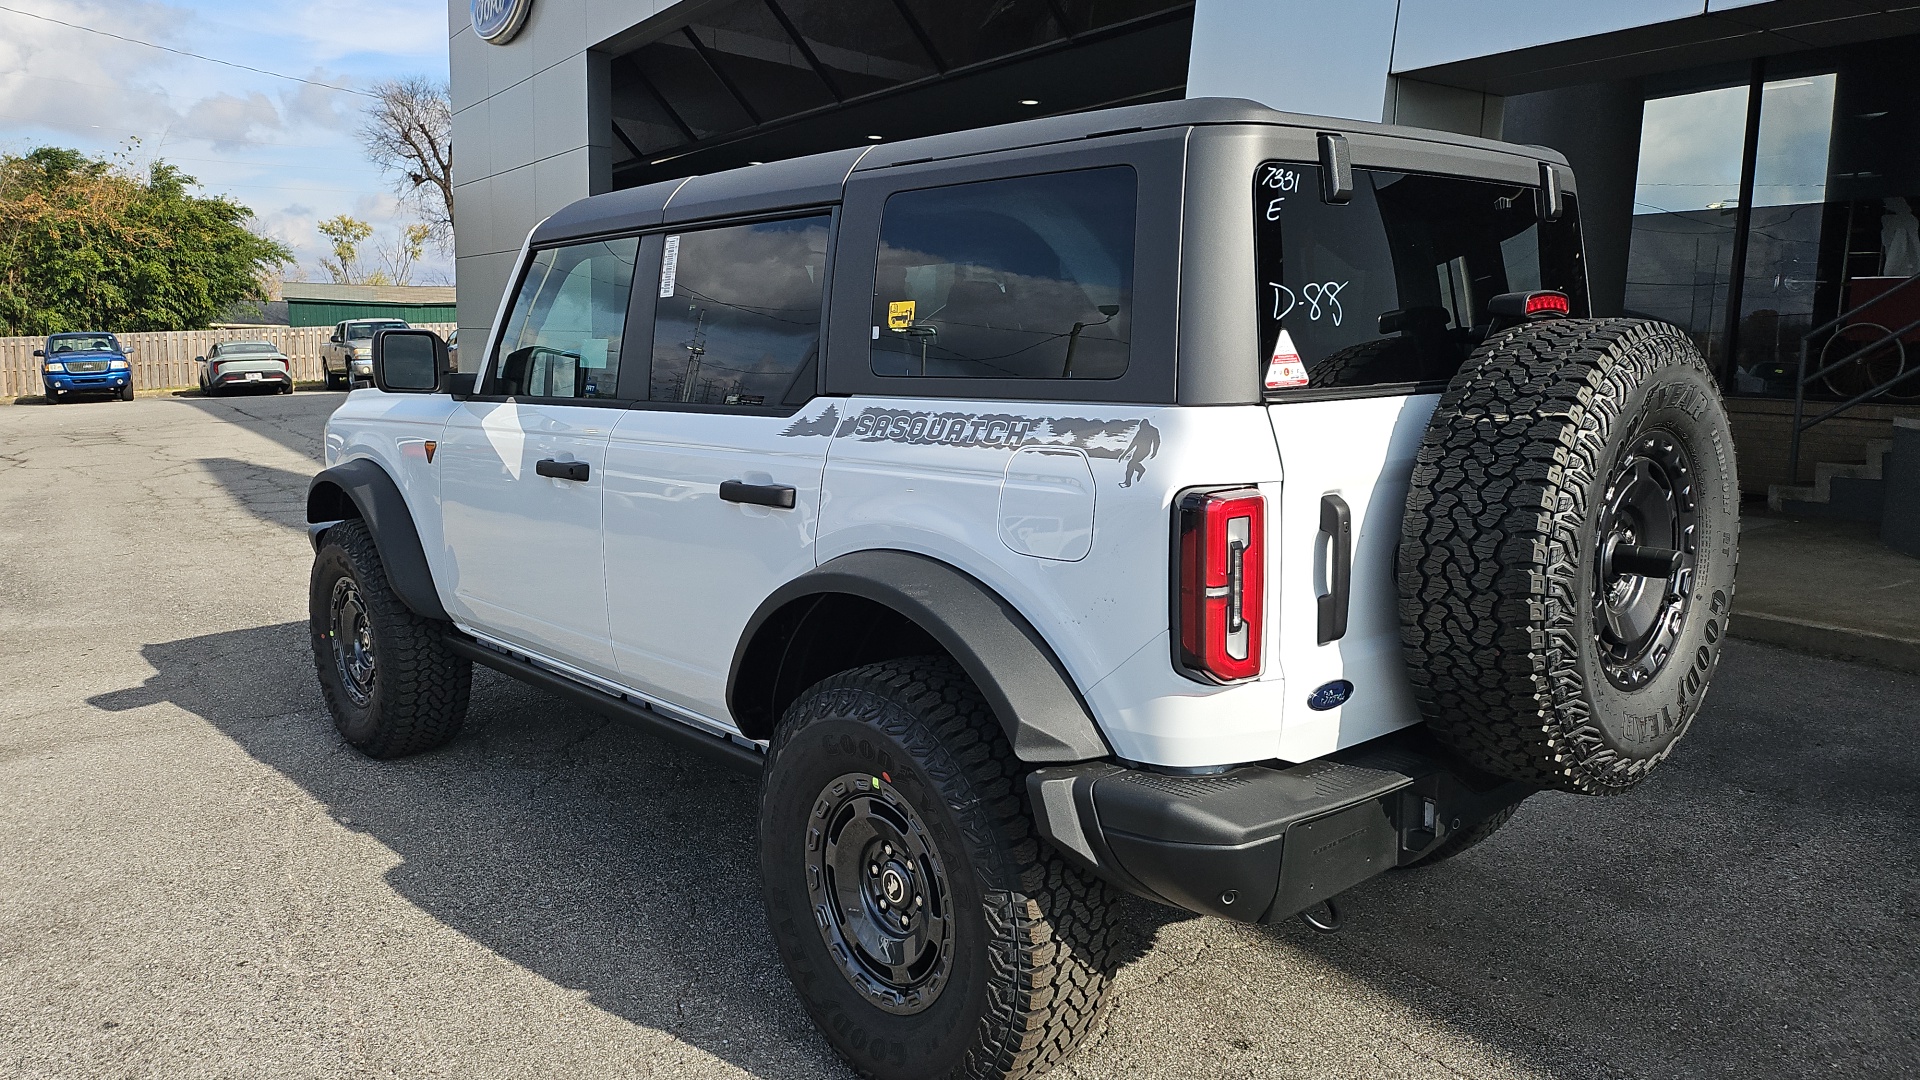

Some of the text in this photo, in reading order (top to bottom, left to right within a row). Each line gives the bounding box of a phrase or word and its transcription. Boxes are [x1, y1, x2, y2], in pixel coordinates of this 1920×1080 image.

[1262, 167, 1300, 193] 7331
[1266, 197, 1285, 221] E
[854, 413, 1032, 447] SASQUATCH
[1319, 688, 1346, 705] Ford
